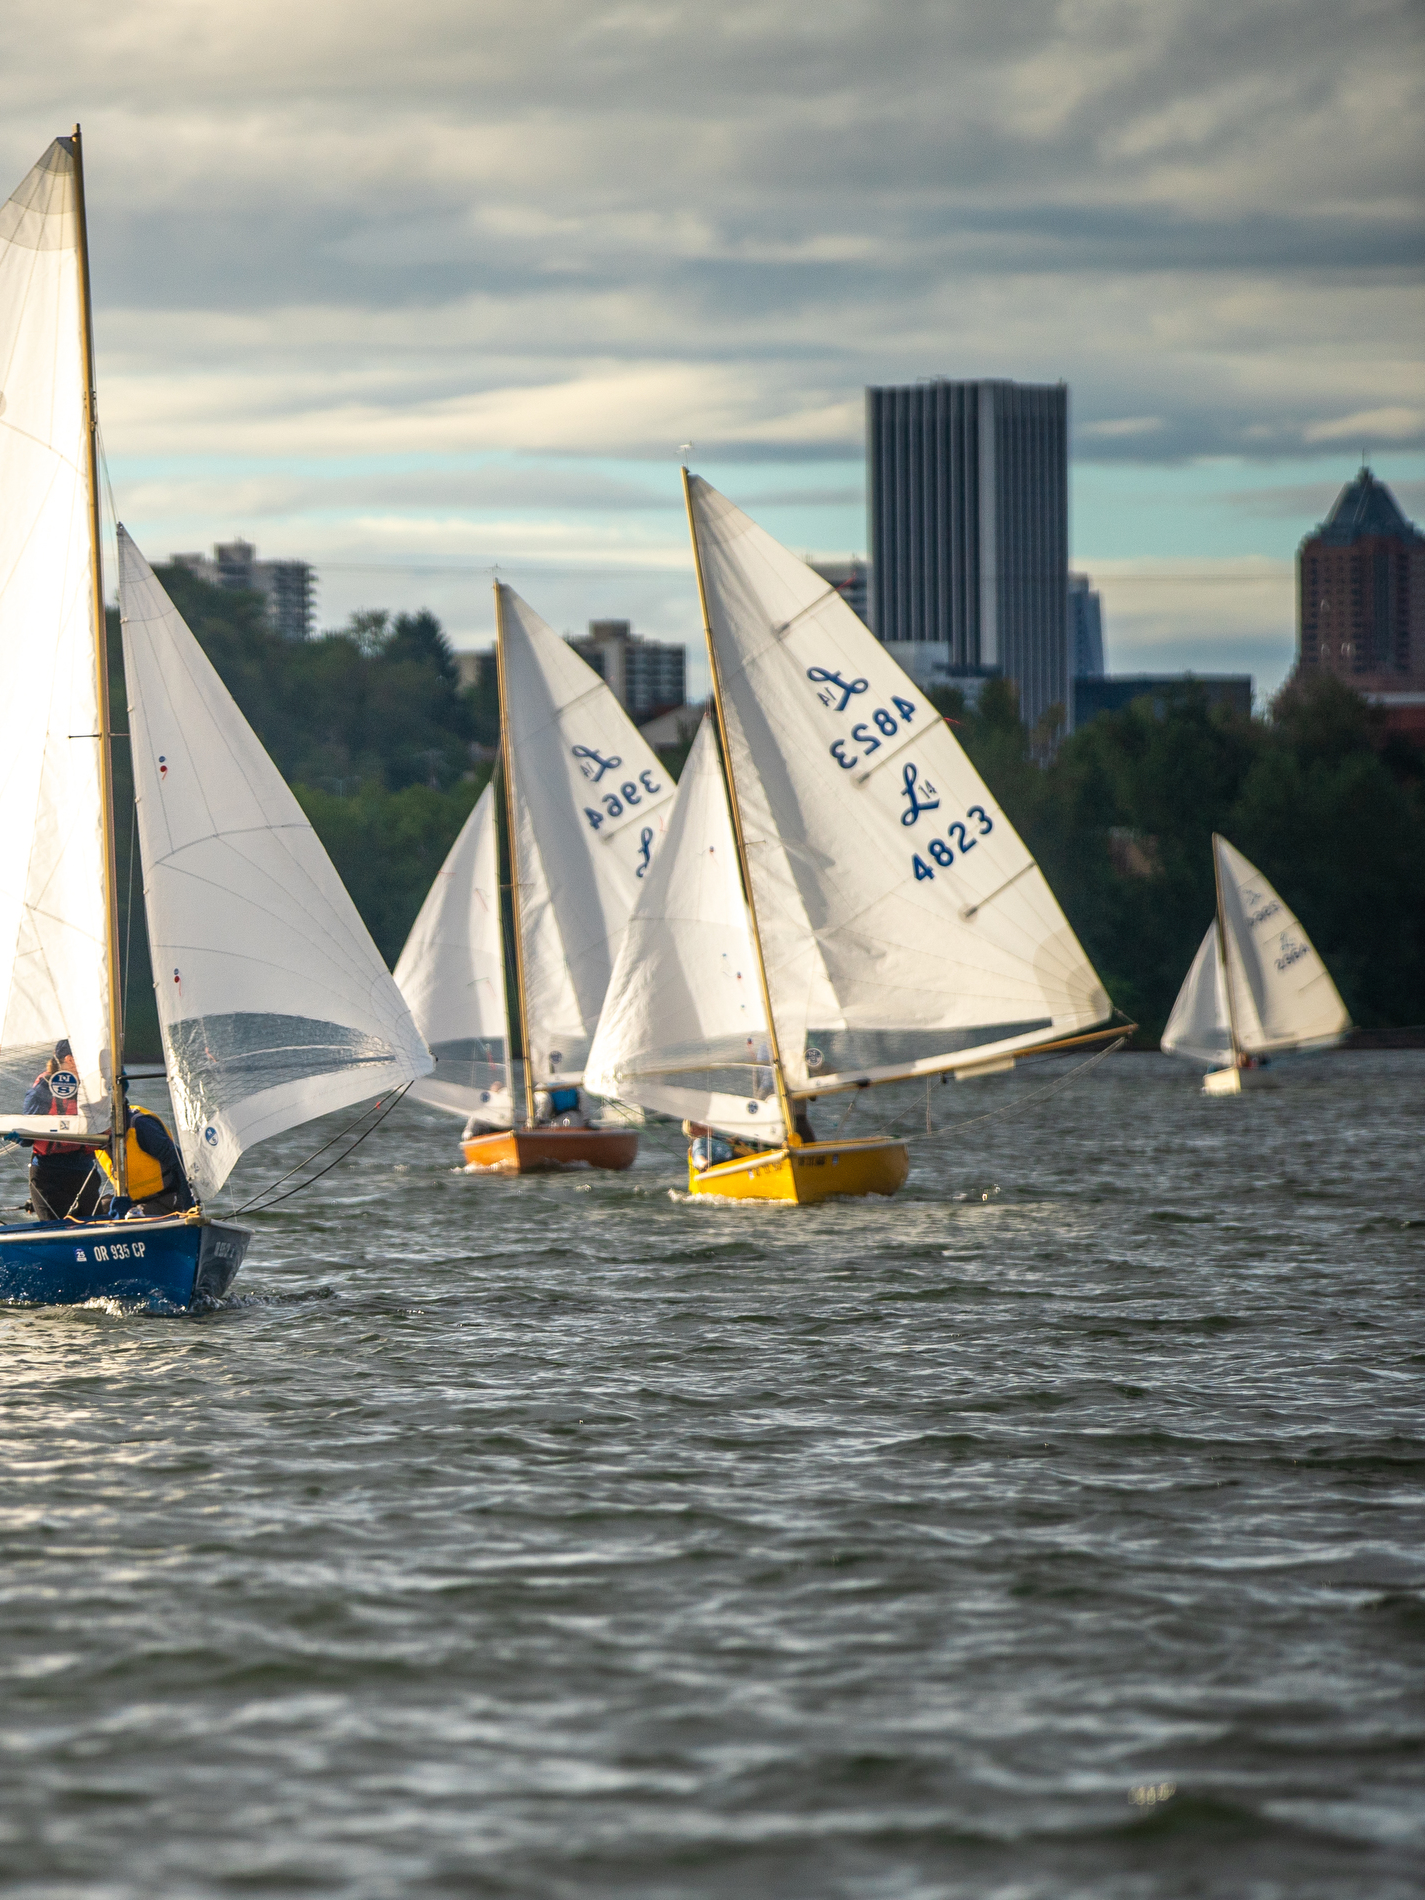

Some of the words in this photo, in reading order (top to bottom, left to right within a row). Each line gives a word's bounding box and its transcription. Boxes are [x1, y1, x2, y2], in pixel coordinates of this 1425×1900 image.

[912, 805, 993, 881] 4823
[94, 1245, 110, 1261] OR
[110, 1244, 130, 1260] 935
[132, 1242, 145, 1258] CP
